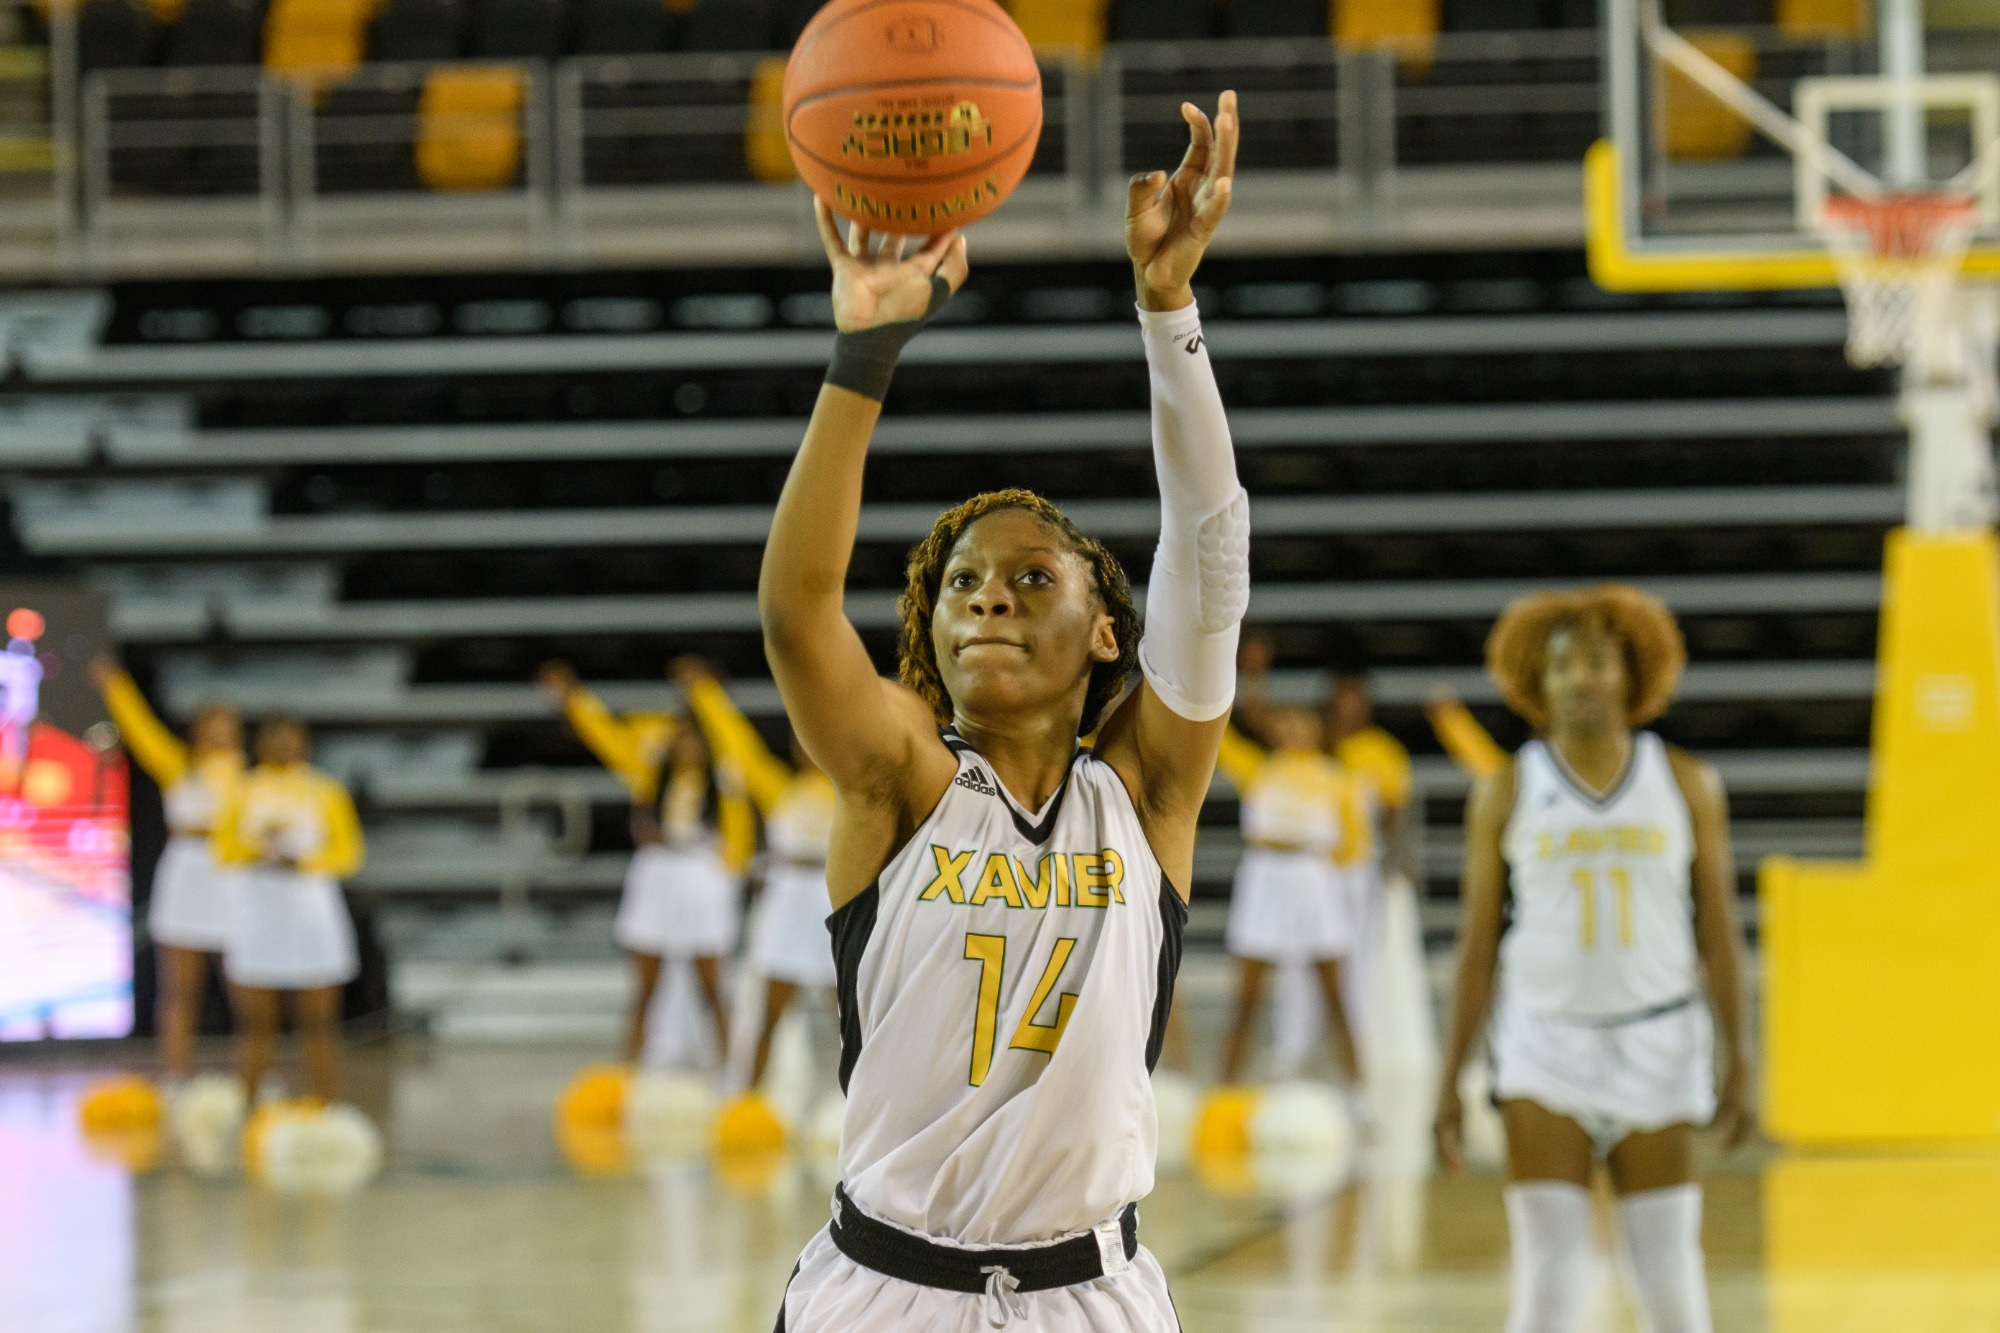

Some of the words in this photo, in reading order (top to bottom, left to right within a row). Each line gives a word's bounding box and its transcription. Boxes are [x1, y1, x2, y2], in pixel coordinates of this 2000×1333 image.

[954, 776, 996, 797] adidas
[917, 844, 1127, 909] XAVIER
[1573, 866, 1633, 948] 11
[963, 932, 1080, 1088] 14
